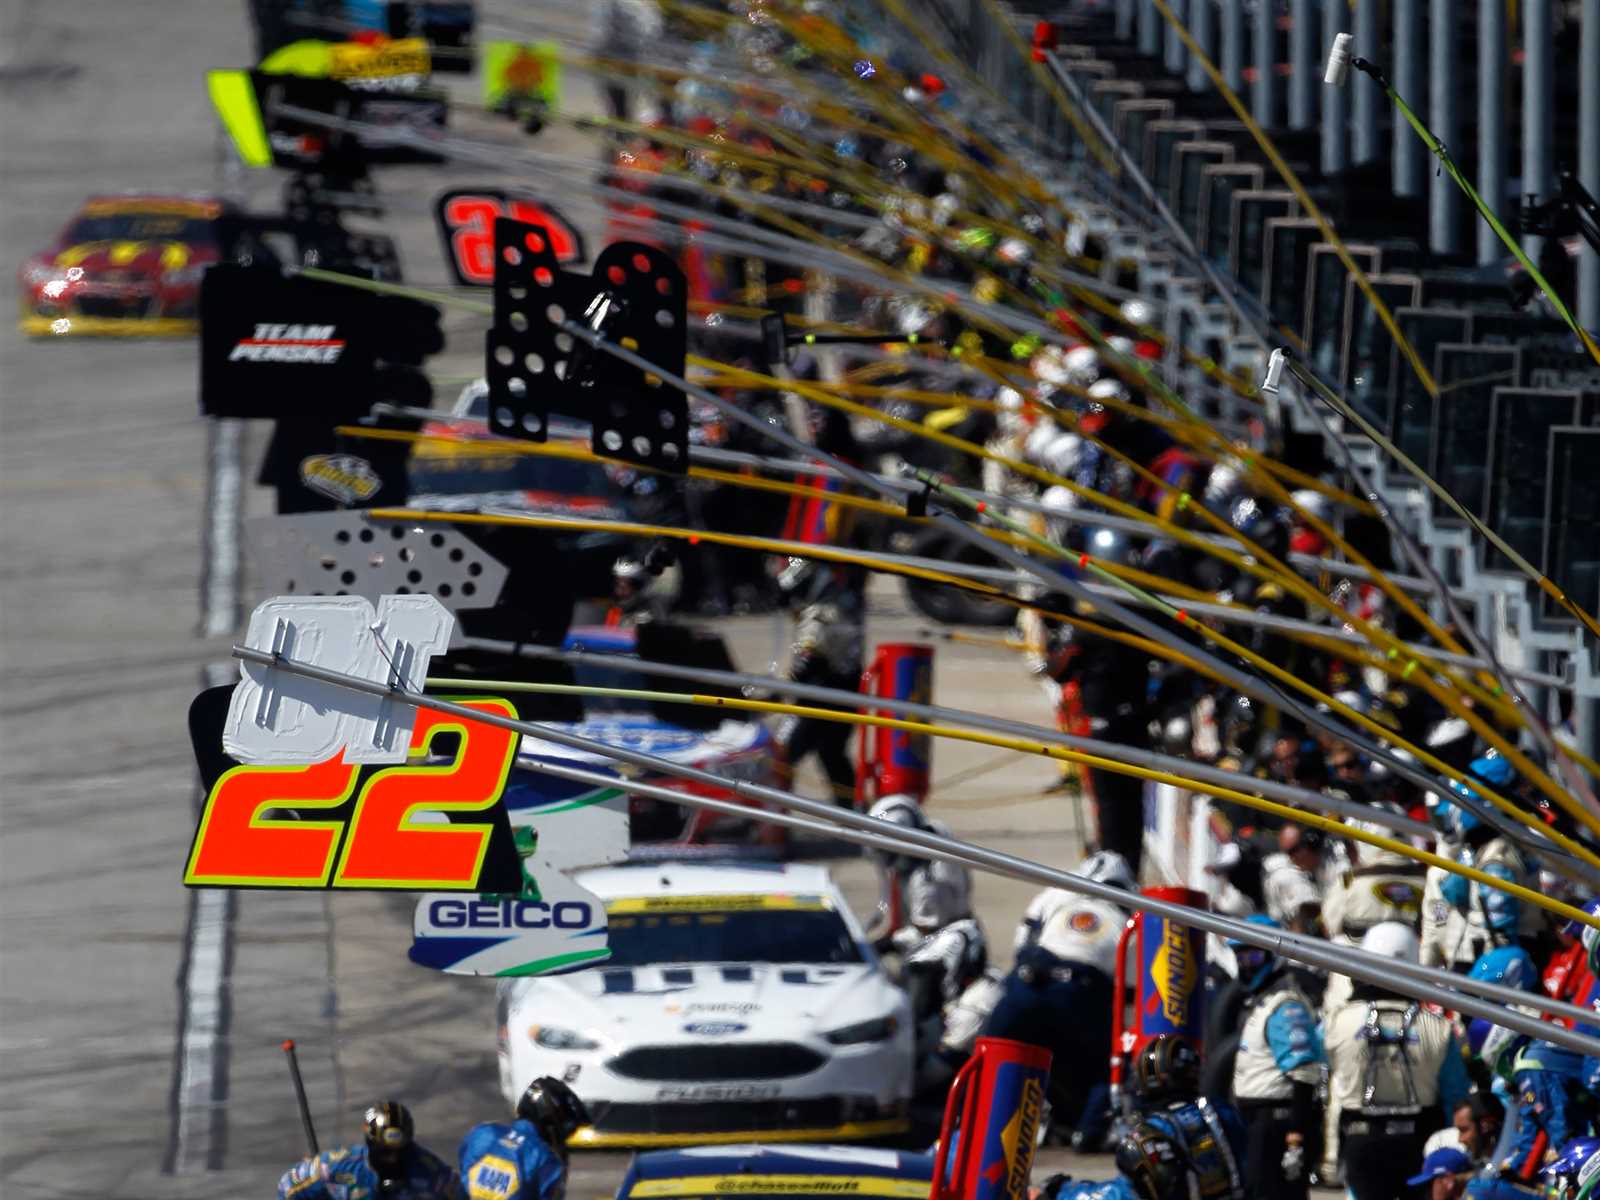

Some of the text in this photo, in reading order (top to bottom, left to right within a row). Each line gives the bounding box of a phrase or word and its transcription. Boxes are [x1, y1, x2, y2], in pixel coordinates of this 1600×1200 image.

[253, 323, 336, 340] TEAM
[184, 696, 520, 890] 22
[429, 900, 592, 929] GEICO
[1010, 1079, 1042, 1196] SUNOCO
